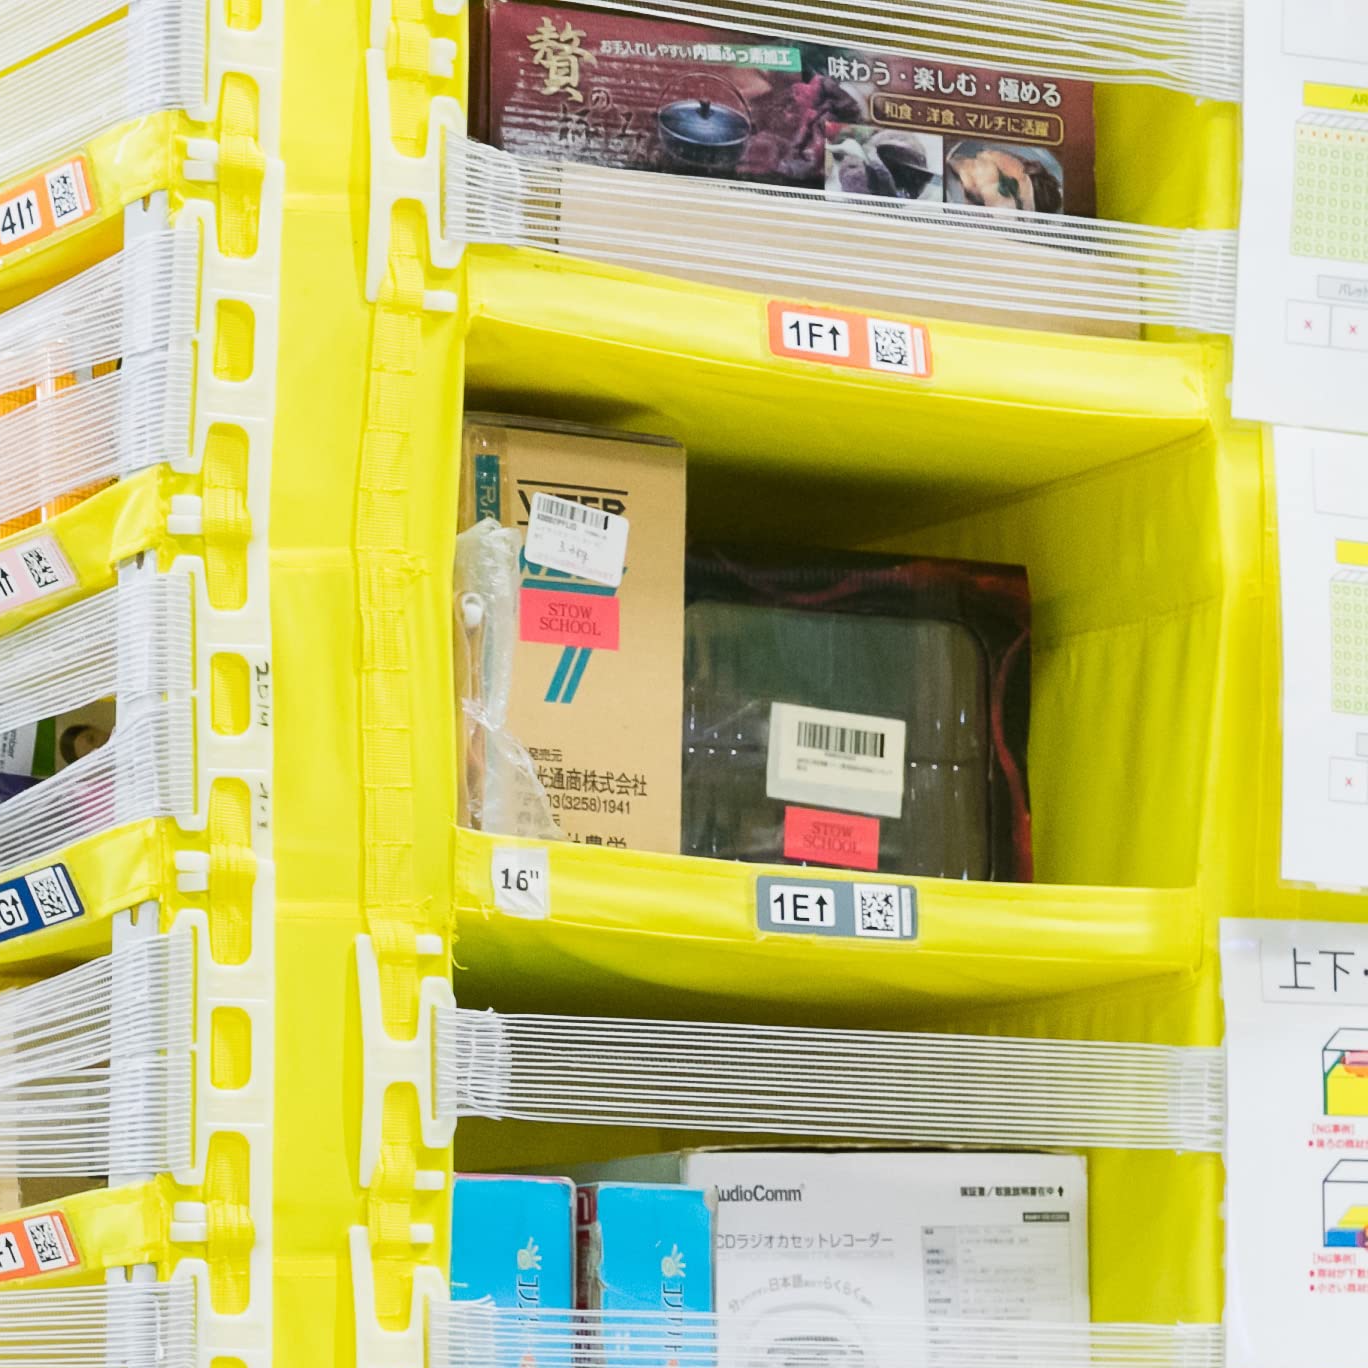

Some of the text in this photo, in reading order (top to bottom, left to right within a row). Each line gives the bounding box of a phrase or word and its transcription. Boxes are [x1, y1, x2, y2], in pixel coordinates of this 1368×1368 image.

[789, 321, 824, 349] 1F
[548, 602, 593, 619] STOW
[538, 615, 602, 636] SCHOOL
[536, 765, 648, 797] 光通商株式会社
[774, 893, 810, 922] 1E
